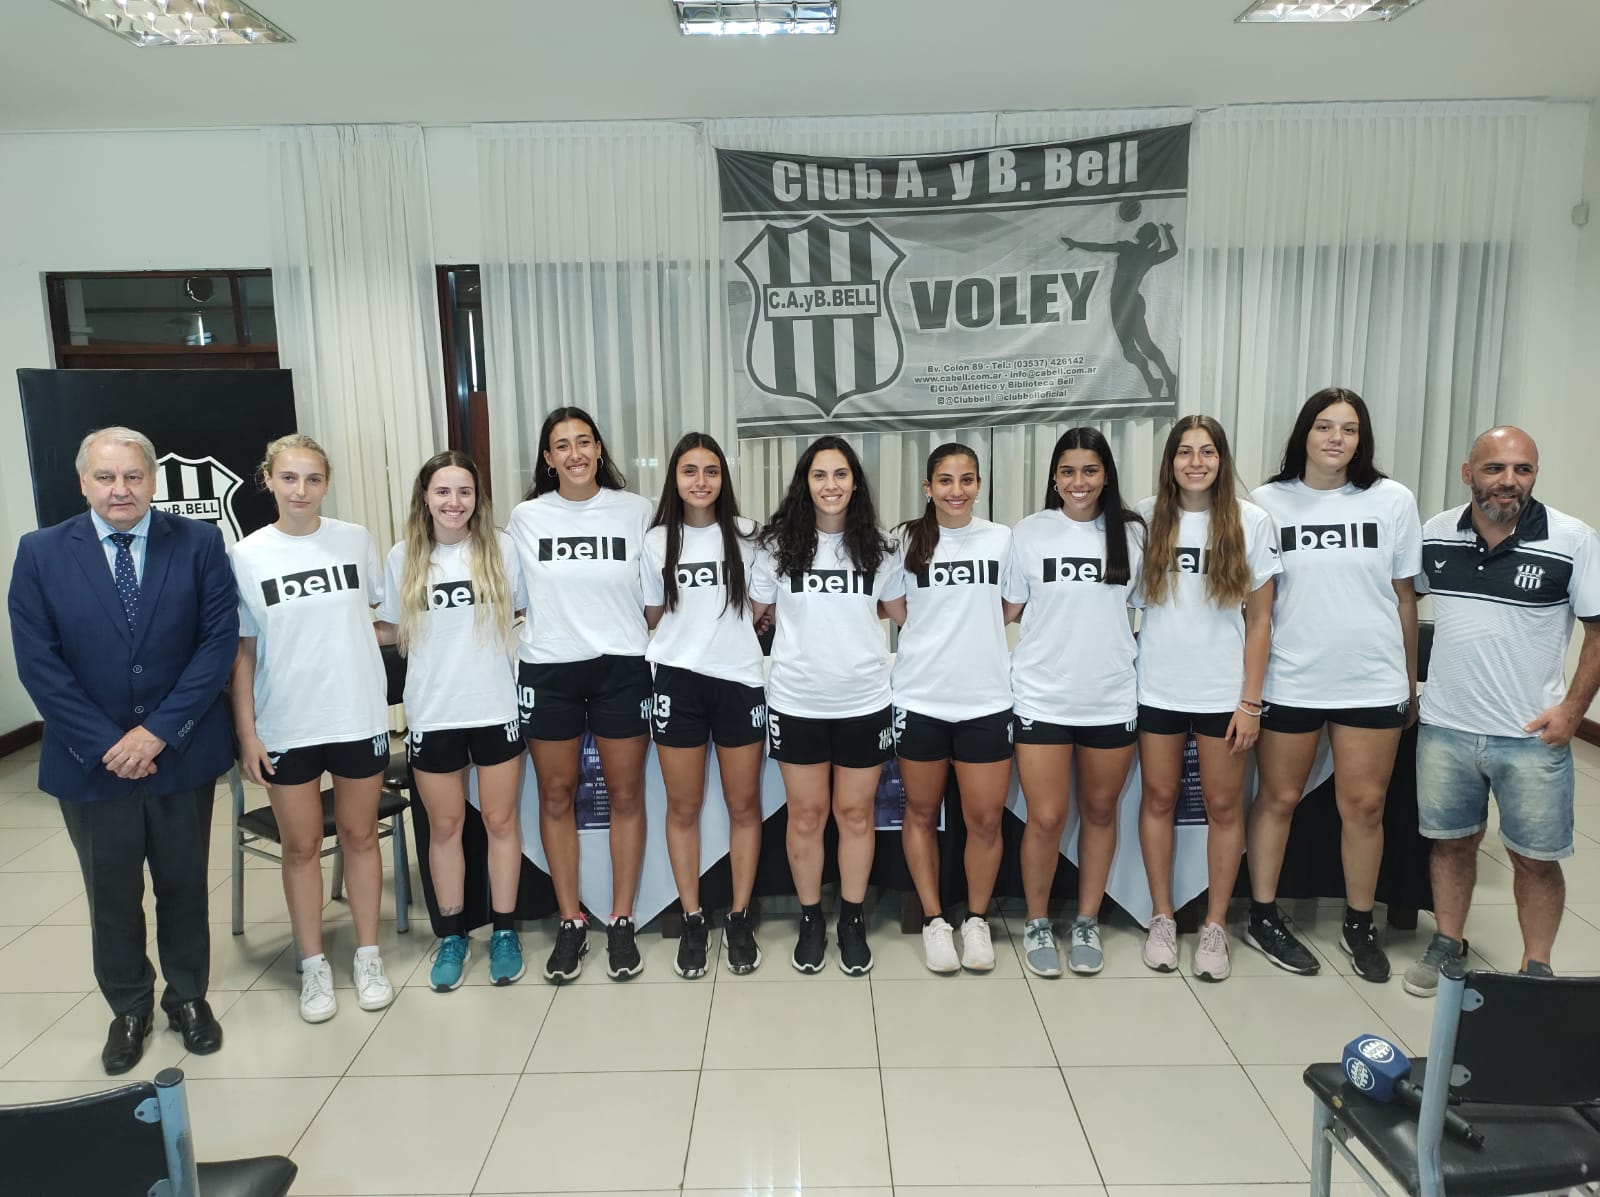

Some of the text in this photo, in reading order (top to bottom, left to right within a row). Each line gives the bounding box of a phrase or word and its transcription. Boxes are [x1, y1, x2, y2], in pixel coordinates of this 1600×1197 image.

[773, 140, 1139, 202] Club A. y B. Bell
[768, 287, 876, 312] C.A.yB.BELL
[908, 269, 1099, 331] VOLEY
[914, 373, 1002, 384] www.cabell.com.ar
[1010, 366, 1097, 379] info@cabell.com.ar
[927, 365, 941, 373] Bv.
[943, 363, 970, 372] Colón
[972, 362, 984, 371] 89
[1013, 359, 1048, 369] (03537)
[1050, 356, 1084, 366] 426142
[938, 384, 959, 393] Club
[961, 382, 998, 392] Atlético
[1008, 379, 1054, 389] Biblioteca
[1057, 377, 1074, 386] Bell
[946, 395, 991, 405] @Clubbell
[552, 536, 614, 561] bell
[1295, 522, 1364, 550] bell
[276, 564, 349, 604] bell
[803, 569, 864, 593] bell
[928, 560, 990, 587] bell
[518, 684, 535, 709] 10
[653, 693, 671, 718] 13
